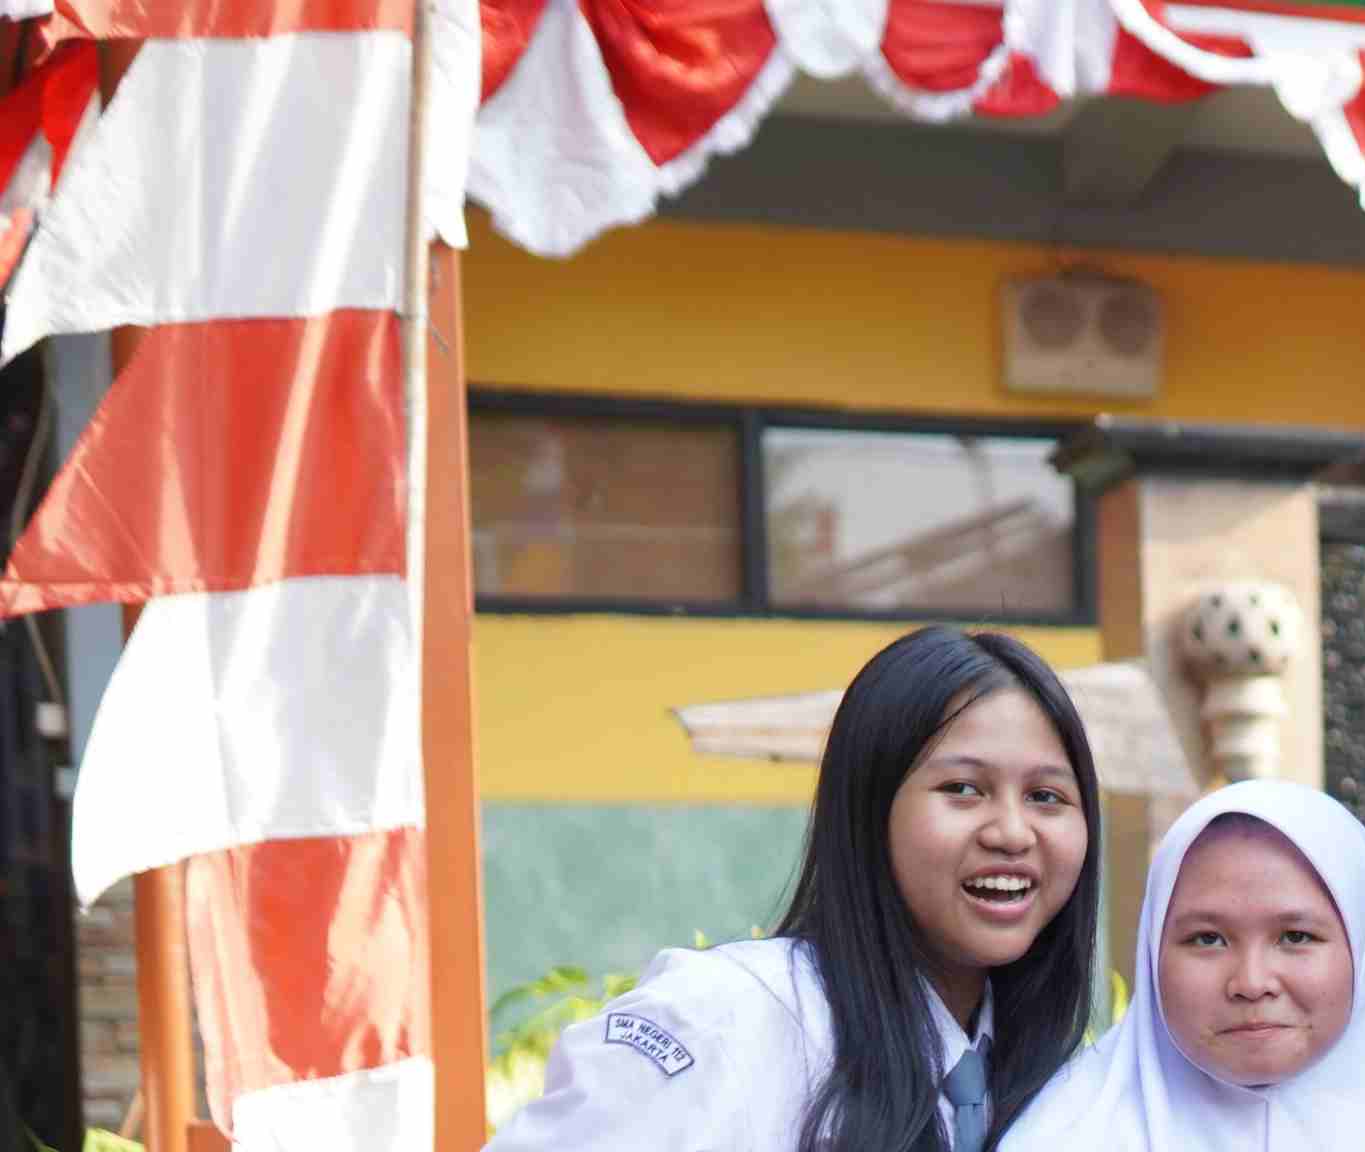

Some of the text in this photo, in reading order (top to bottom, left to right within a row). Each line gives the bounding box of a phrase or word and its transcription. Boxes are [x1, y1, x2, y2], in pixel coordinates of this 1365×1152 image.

[615, 1018, 634, 1029] SMA
[638, 1023, 672, 1049] NEGERI
[620, 1031, 669, 1063] JAKARTA
